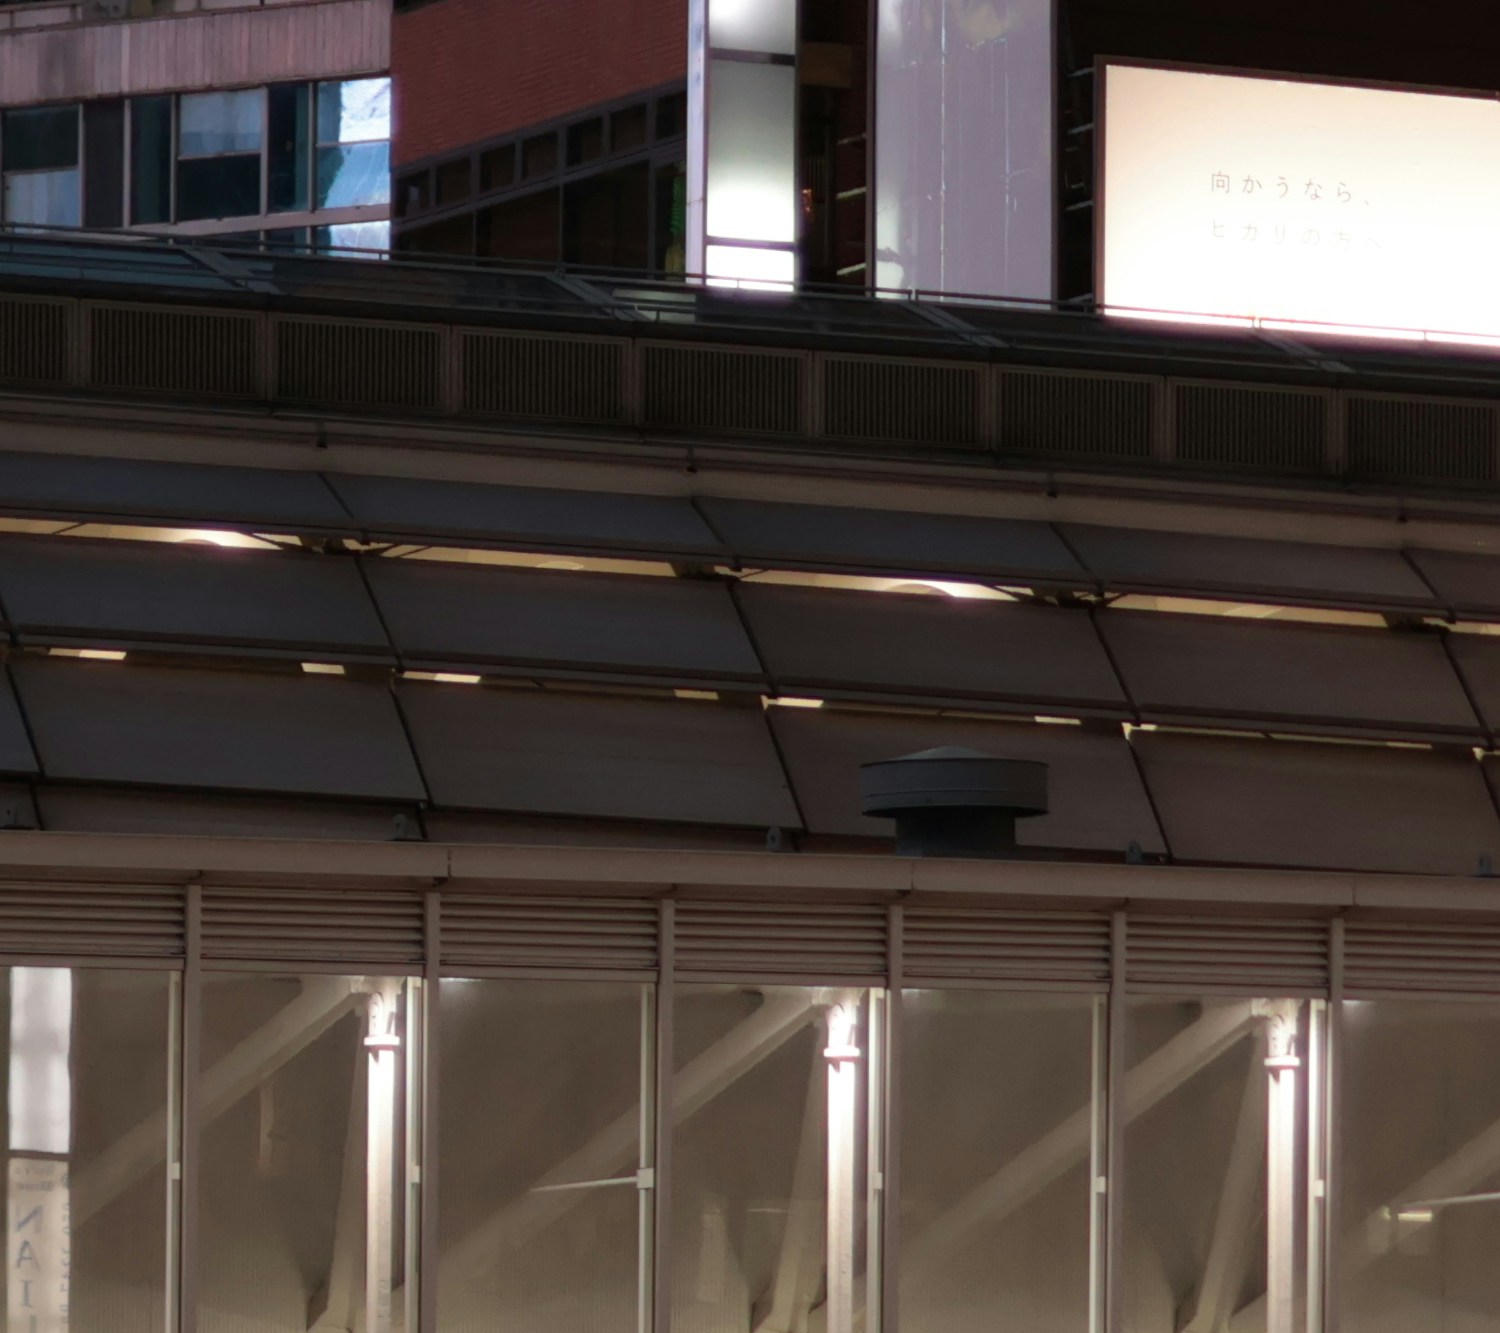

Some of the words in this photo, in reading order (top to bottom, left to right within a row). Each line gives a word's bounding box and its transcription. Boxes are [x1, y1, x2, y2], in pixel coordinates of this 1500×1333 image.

[1210, 170, 1370, 205] 向かうなら、
[1212, 219, 1383, 250] ヒカリの方へ
